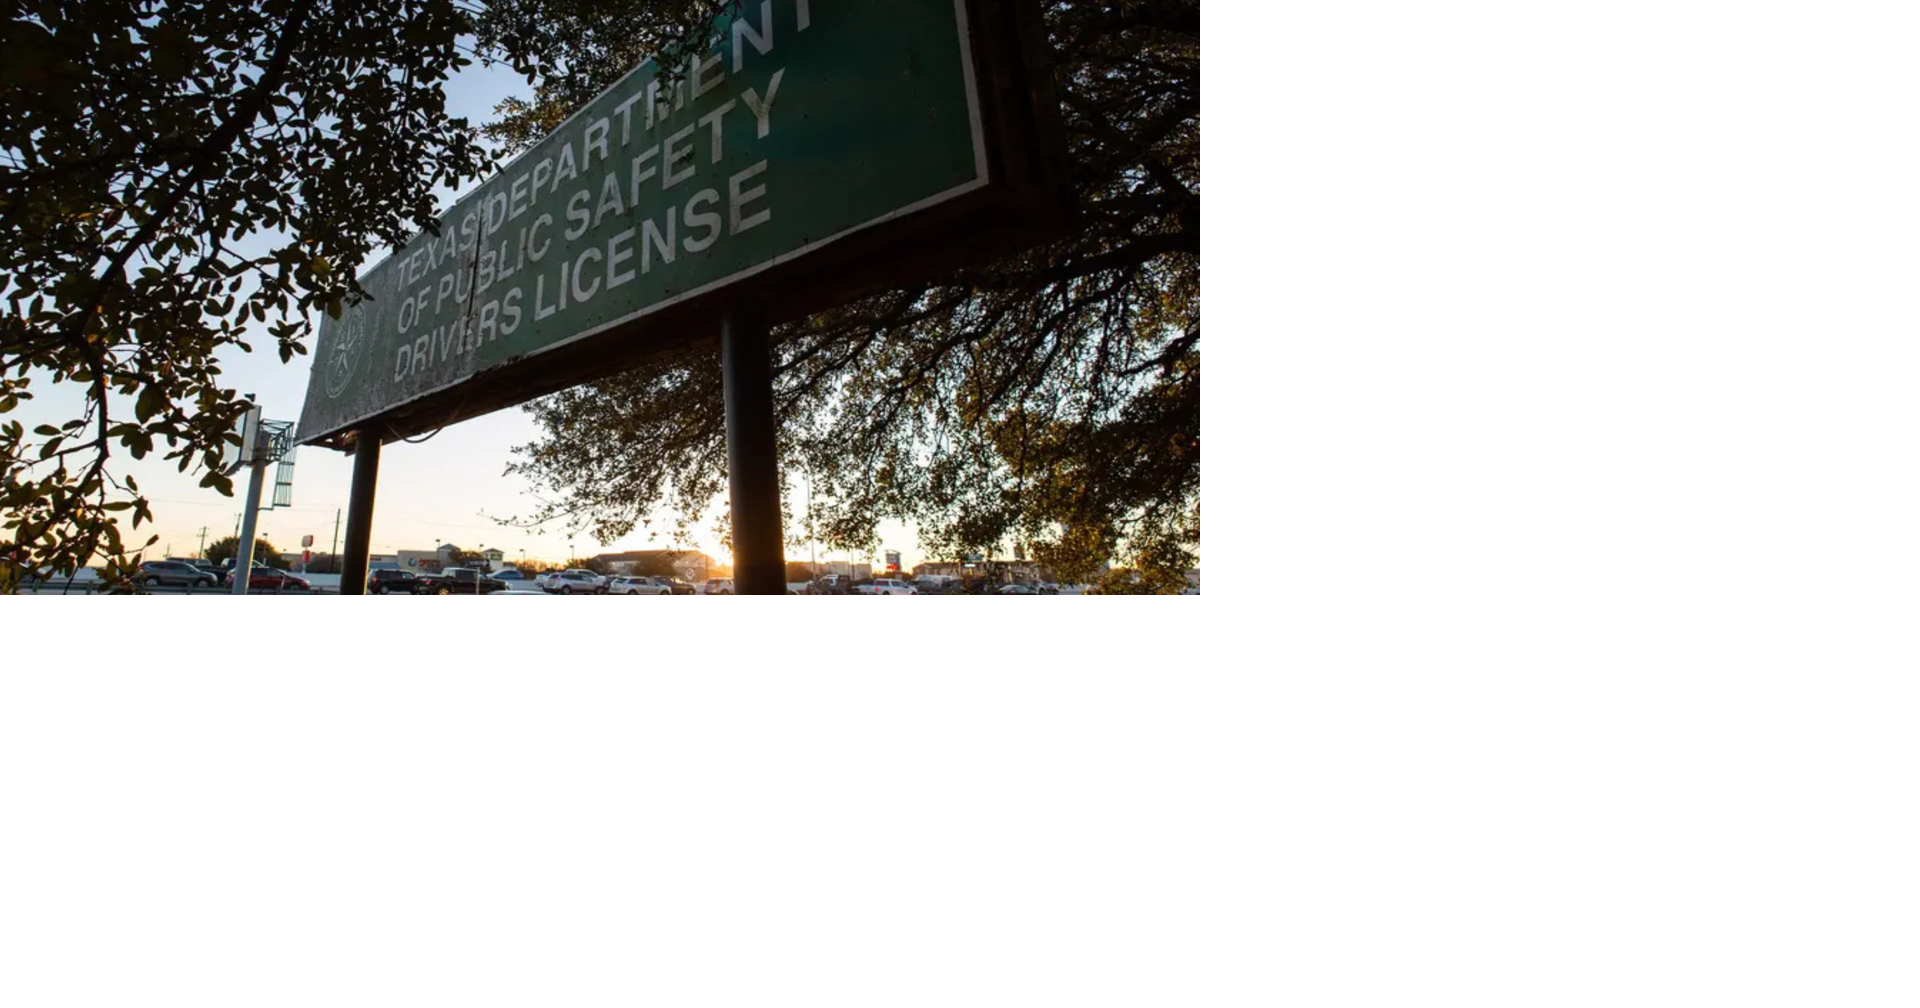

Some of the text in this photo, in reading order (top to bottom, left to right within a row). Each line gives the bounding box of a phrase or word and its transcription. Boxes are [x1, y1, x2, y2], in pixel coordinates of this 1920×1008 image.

[393, 286, 523, 383] DRIVERS
[534, 159, 771, 322] LICENSE
[397, 67, 786, 335] OF PUBLIC SAFETY
[398, 212, 476, 292] TEXAS
